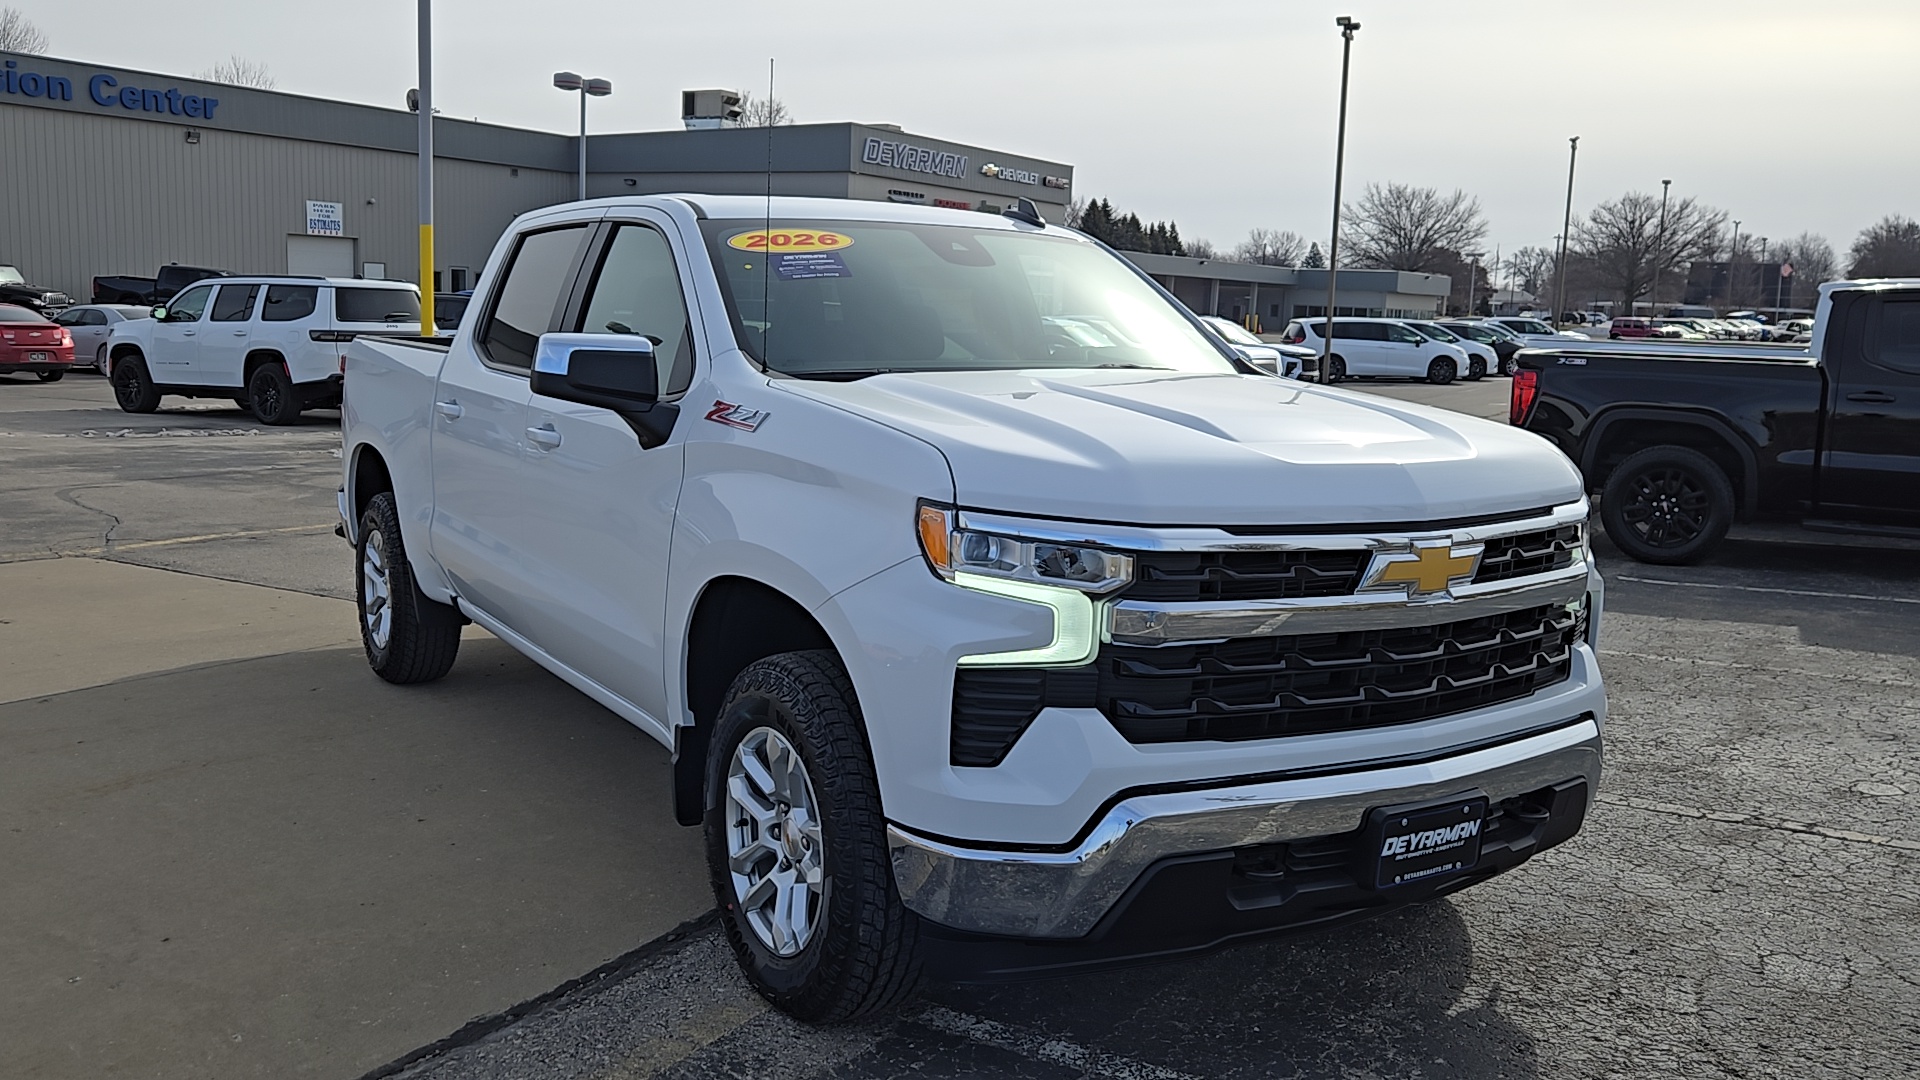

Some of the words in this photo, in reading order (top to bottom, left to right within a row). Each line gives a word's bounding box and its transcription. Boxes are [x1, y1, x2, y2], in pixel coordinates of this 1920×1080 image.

[89, 74, 219, 119] Center
[862, 137, 968, 180] DEYARMAN
[998, 166, 1039, 186] CHEVROLET
[309, 218, 341, 231] ESTIMATES
[745, 233, 840, 248] 2026
[703, 399, 771, 433] Z71
[1380, 818, 1482, 857] DEYARMAN
